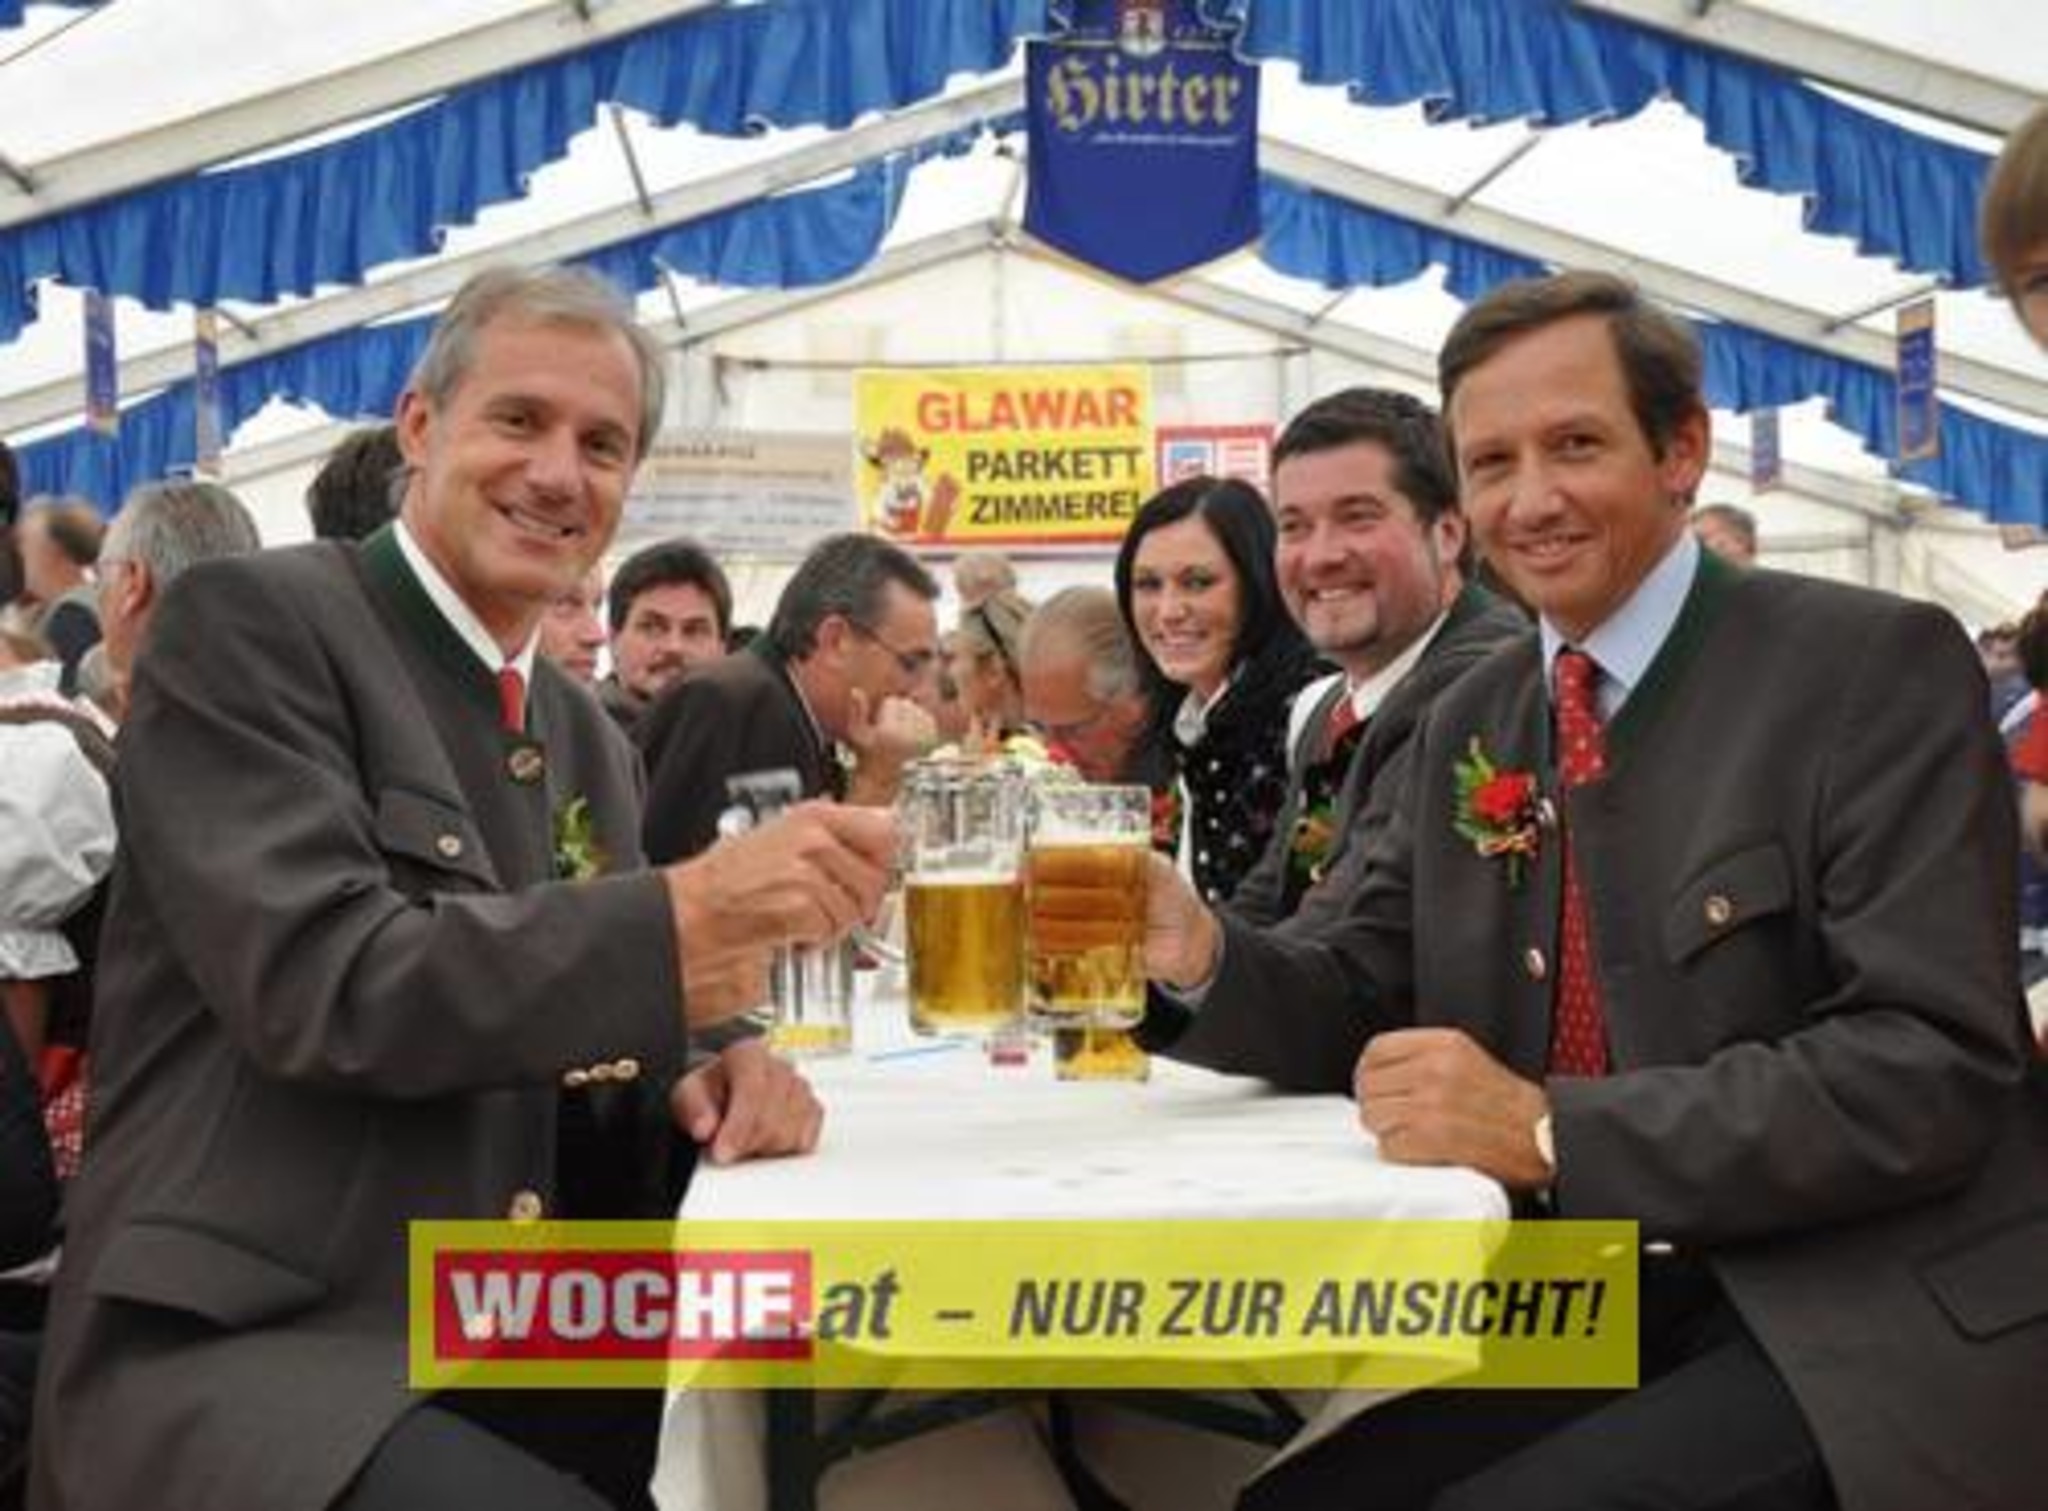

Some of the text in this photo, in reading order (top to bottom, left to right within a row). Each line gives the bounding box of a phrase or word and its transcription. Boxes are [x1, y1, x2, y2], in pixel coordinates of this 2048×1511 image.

[1048, 54, 1240, 132] Hirter
[916, 386, 1140, 434] GLAWAR
[966, 446, 1143, 482] PARKETT
